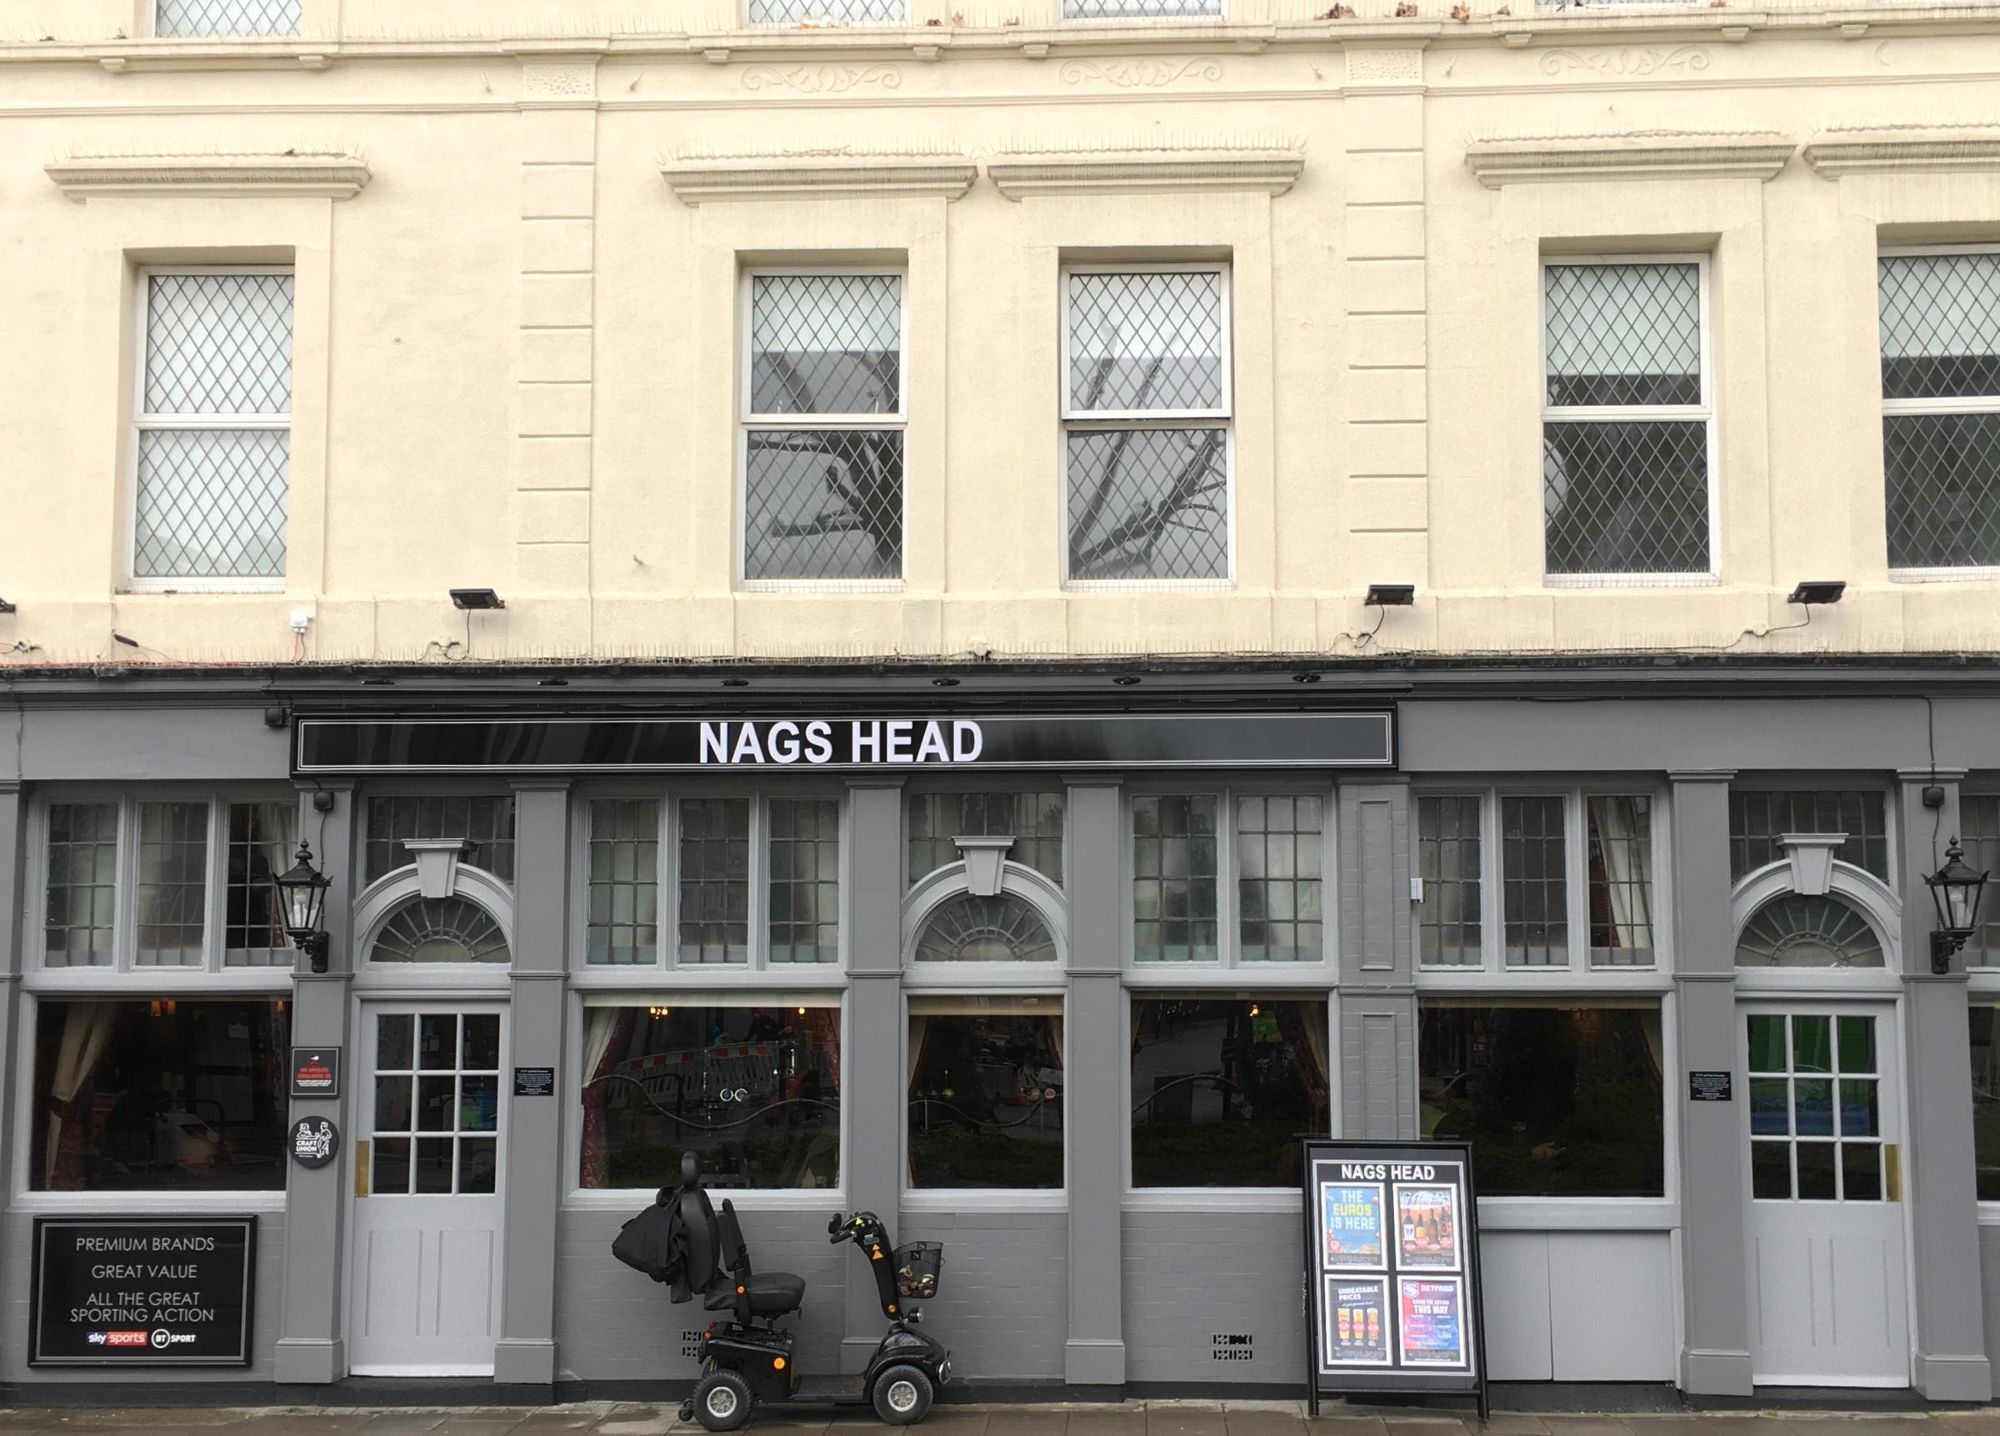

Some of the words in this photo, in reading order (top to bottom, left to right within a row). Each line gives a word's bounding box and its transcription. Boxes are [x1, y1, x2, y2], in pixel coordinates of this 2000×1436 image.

[700, 721, 833, 763] NAGS
[851, 720, 984, 762] HEAD
[1341, 1164, 1386, 1180] NAGS
[1391, 1165, 1435, 1181] HEAD
[1341, 1190, 1363, 1202] THE
[1333, 1203, 1372, 1217] EUROS
[1331, 1217, 1342, 1229] IS
[1345, 1217, 1376, 1230] HERE
[76, 1237, 148, 1252] PREMIUM
[152, 1236, 215, 1251] BRANDS
[91, 1265, 143, 1279] GREAT
[148, 1264, 197, 1279] VALUE
[86, 1292, 113, 1306] ALL
[117, 1292, 145, 1306] THE
[148, 1292, 200, 1306] GREAT
[70, 1308, 148, 1323] SPORTING
[152, 1308, 214, 1322] ACTION
[88, 1332, 107, 1345] sky
[109, 1333, 146, 1345] sports
[170, 1334, 196, 1343] SPORT
